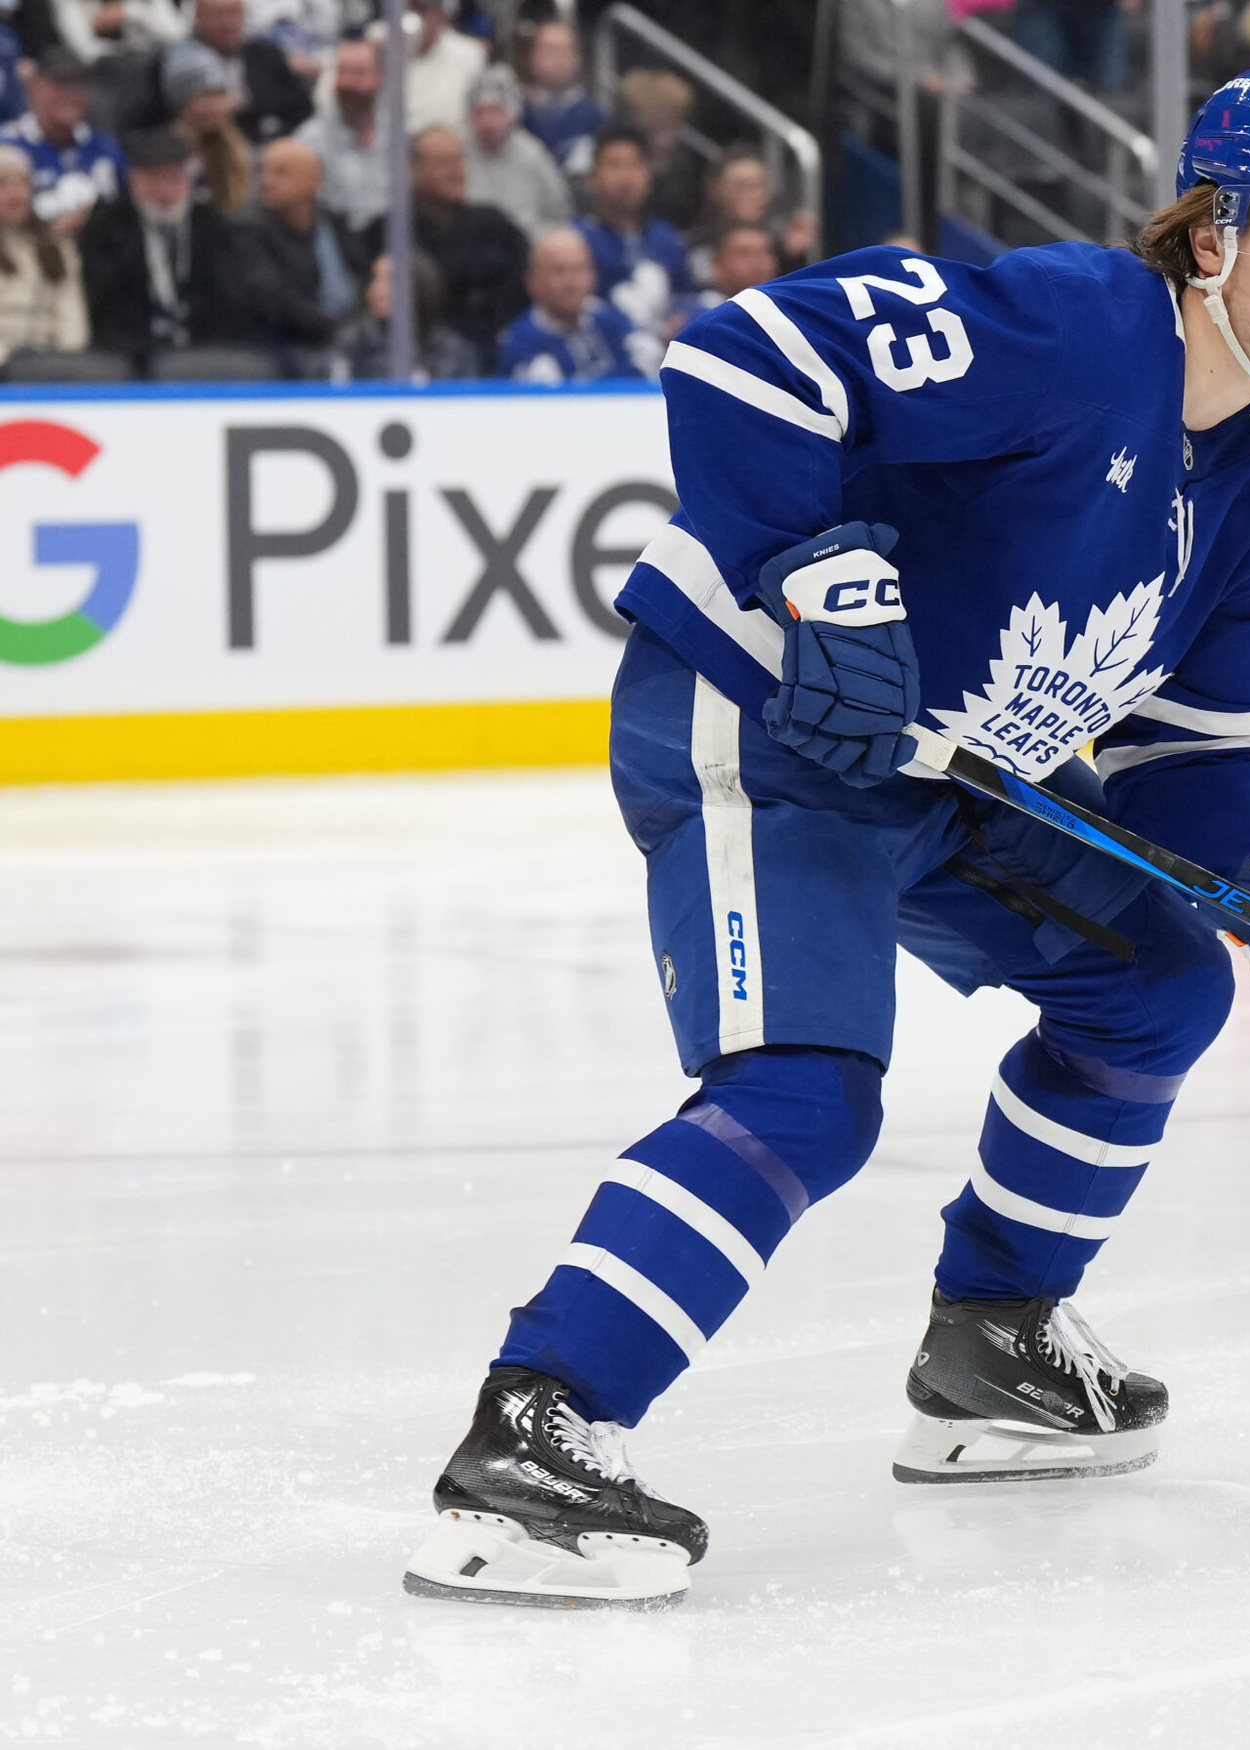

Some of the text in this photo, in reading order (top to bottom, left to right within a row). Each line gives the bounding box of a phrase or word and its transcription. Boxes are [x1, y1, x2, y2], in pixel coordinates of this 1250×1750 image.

[836, 257, 975, 393] 23
[224, 421, 678, 650] Pixe
[813, 543, 840, 559] KNIES
[1004, 691, 1084, 746] MAPLE
[1013, 664, 1112, 734] TORONTO
[980, 713, 1060, 765] LEAFS
[727, 910, 748, 1001] CCM
